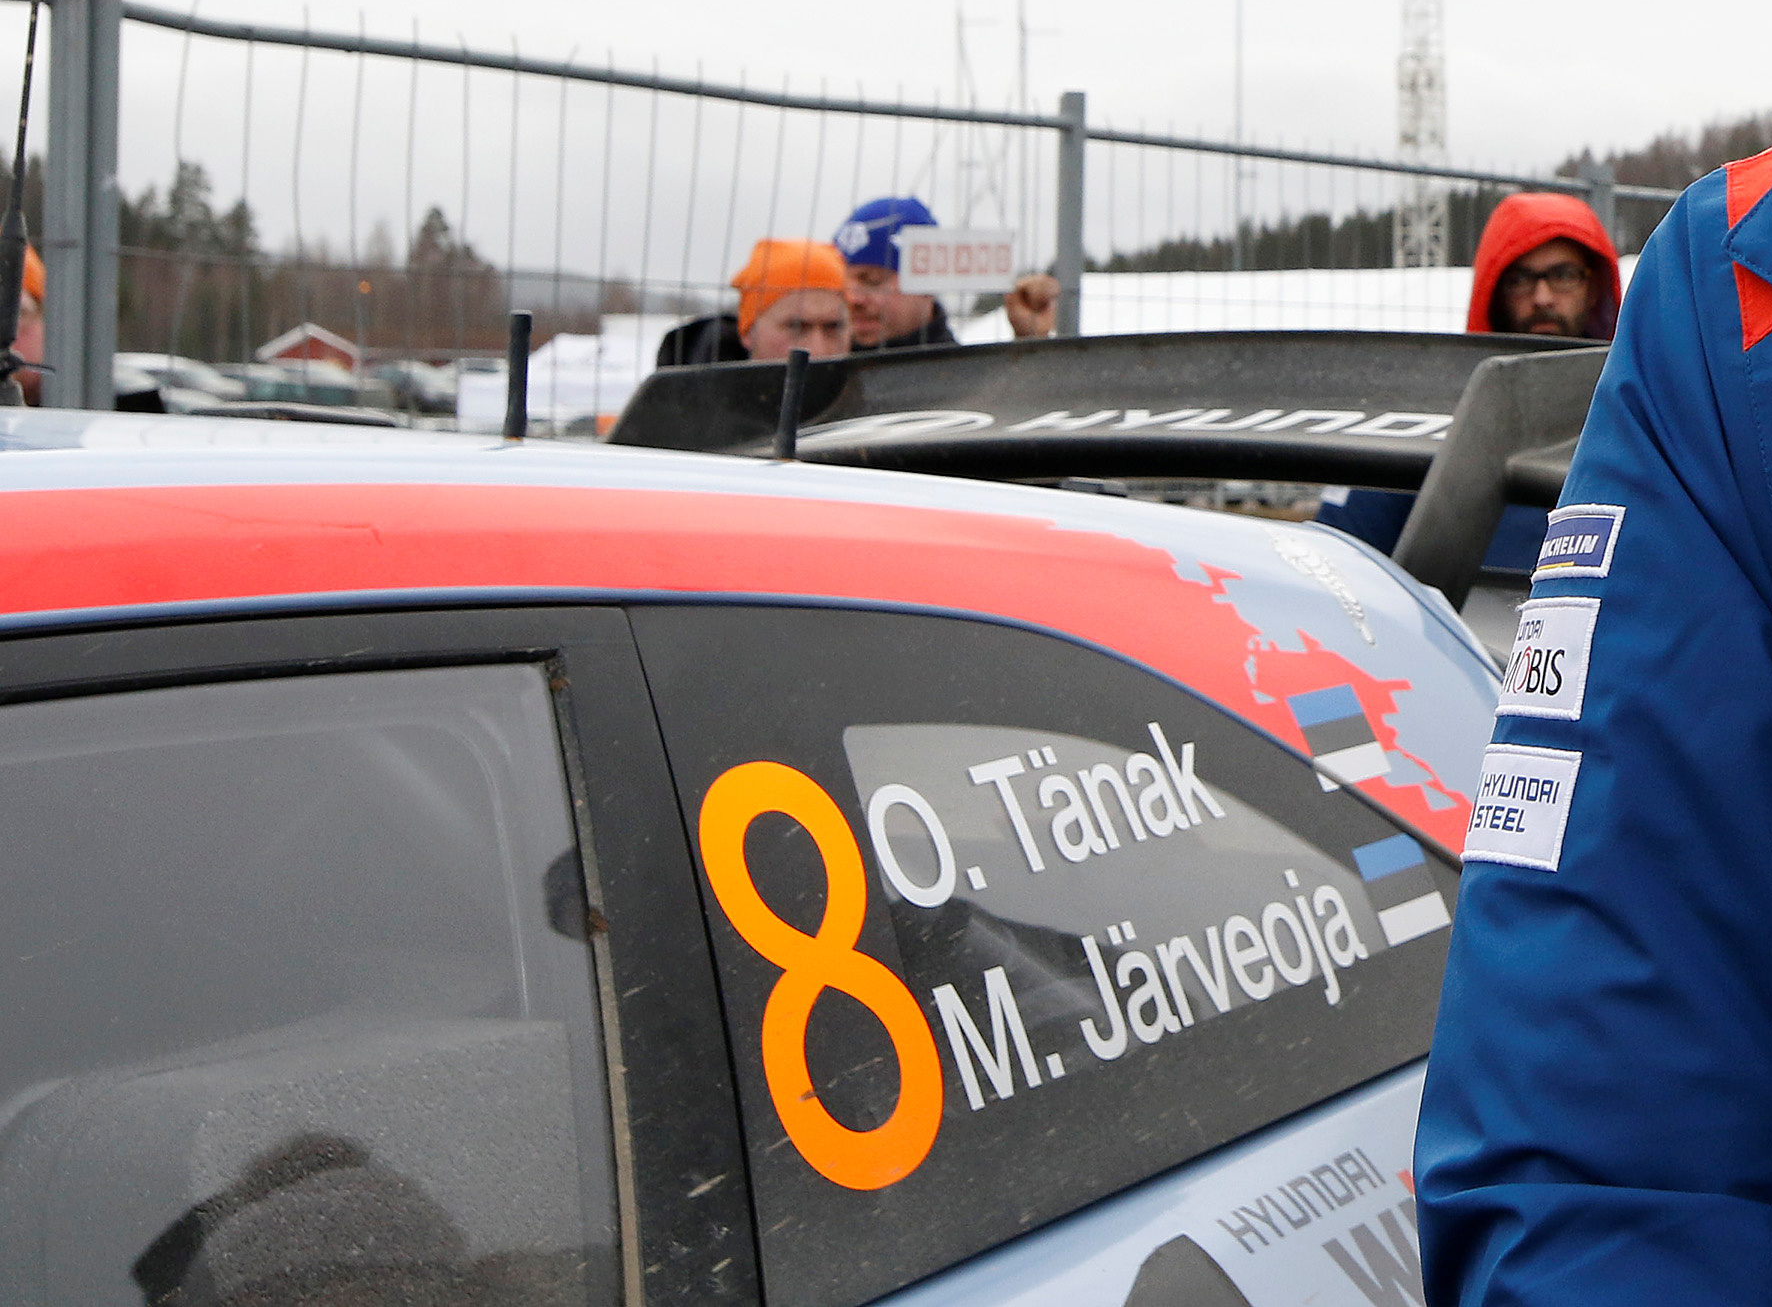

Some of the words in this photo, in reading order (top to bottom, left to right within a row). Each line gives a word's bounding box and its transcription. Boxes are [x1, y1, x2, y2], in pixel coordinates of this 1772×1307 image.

[1006, 408, 1453, 440] HYUND
[1517, 619, 1545, 642] UNDAI
[867, 783, 989, 908] O.
[968, 722, 1226, 873] Tänak
[1474, 805, 1526, 833] STEEL
[1481, 773, 1560, 805] HYUNDAI
[699, 761, 944, 1191] 8
[932, 966, 1067, 1111] M.
[1079, 869, 1367, 1061] Järveoja
[1216, 1147, 1386, 1254] HYUNDAI
